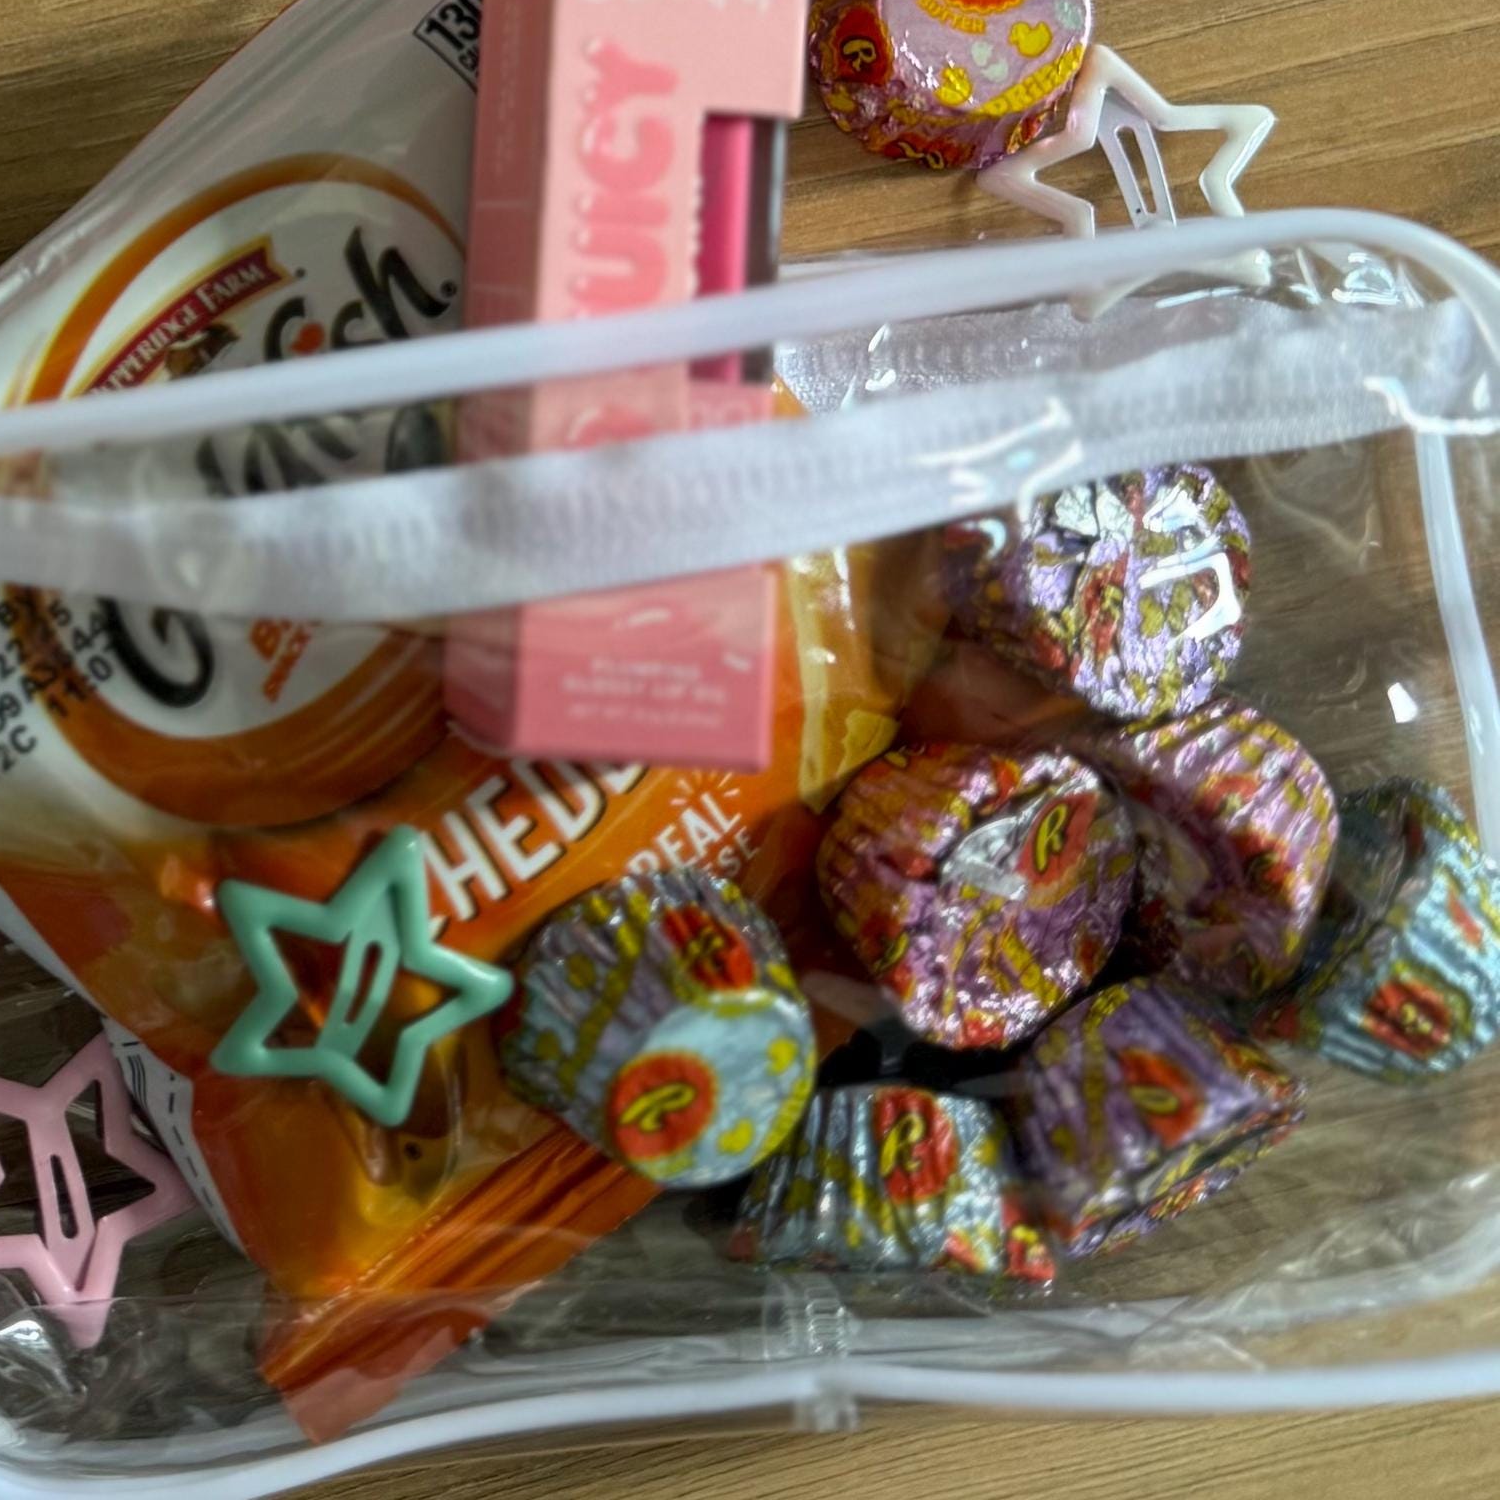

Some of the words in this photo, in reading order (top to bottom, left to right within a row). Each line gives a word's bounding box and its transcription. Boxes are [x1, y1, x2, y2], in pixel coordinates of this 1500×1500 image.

[564, 35, 682, 322] UICY
[90, 301, 200, 394] PPERIDGE
[194, 263, 267, 315] FARM
